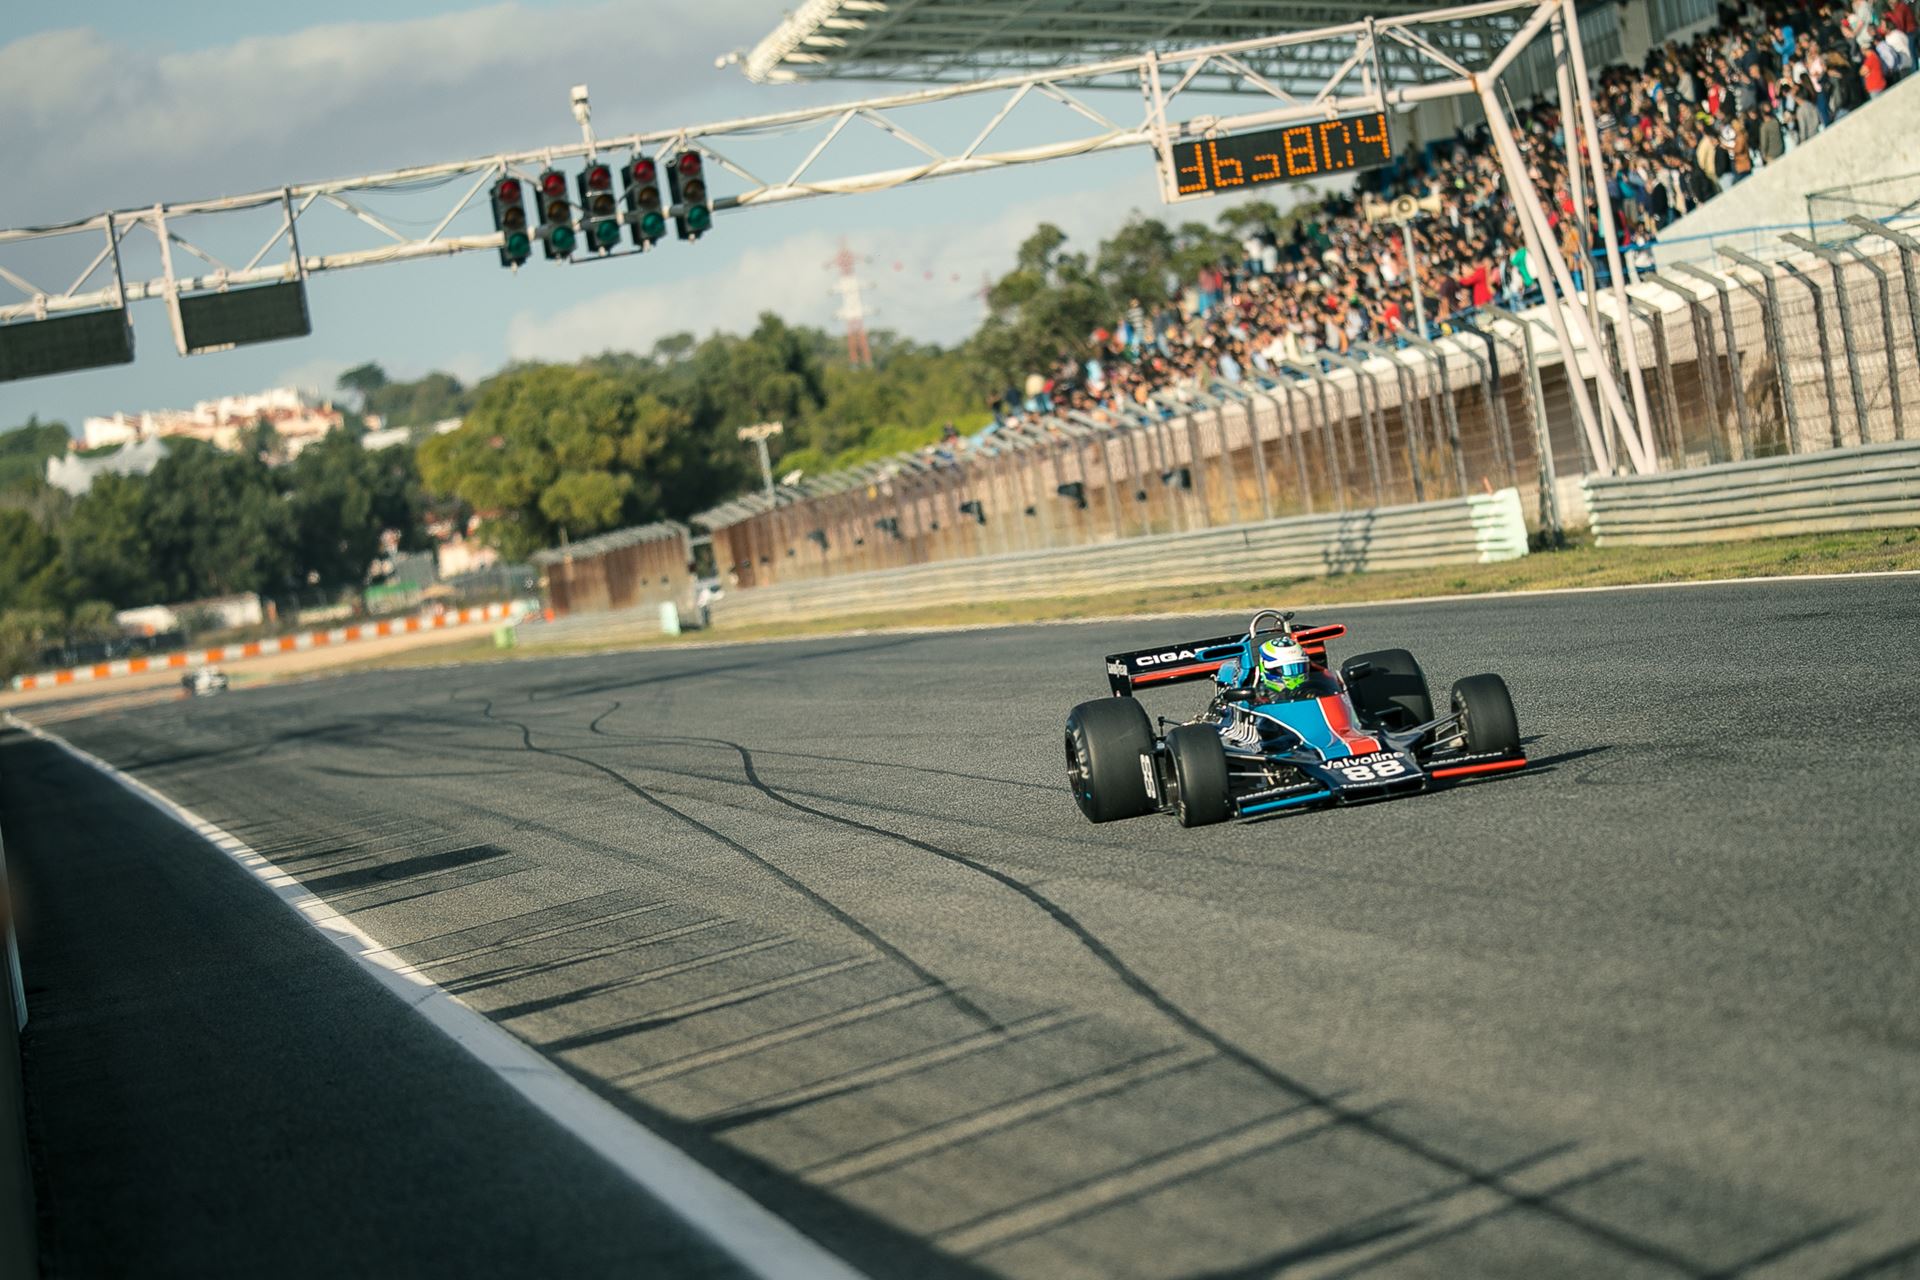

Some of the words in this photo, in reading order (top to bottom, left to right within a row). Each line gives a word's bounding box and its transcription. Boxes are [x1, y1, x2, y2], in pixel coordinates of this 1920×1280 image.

[1320, 752, 1405, 770] Valvoline
[1341, 760, 1406, 781] 88
[1140, 754, 1157, 799] 88
